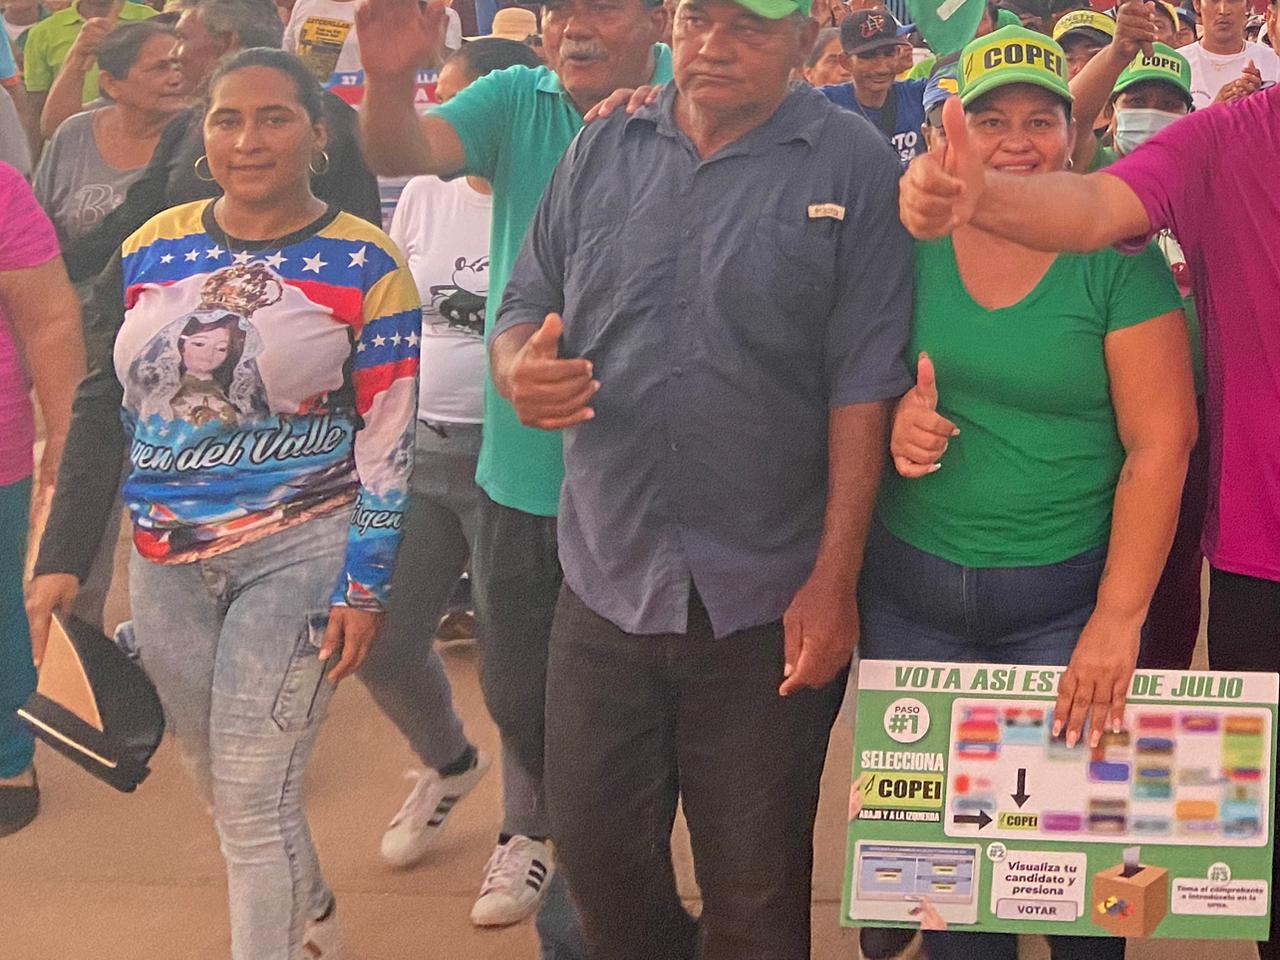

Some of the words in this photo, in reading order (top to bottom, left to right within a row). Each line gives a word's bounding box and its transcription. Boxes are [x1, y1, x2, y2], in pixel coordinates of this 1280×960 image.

[984, 43, 1063, 78] COPEI
[1141, 56, 1181, 74] COPEI
[176, 431, 245, 472] del
[250, 417, 347, 464] Valle
[895, 666, 961, 689] VOTA
[970, 666, 1017, 691] ASÍ
[1131, 674, 1165, 697] DE
[1171, 675, 1243, 699] JULIO
[895, 706, 920, 714] PASO
[889, 714, 919, 734] #1
[861, 750, 944, 772] SELECCIONA
[878, 778, 942, 800] COPEI
[1006, 815, 1038, 827] COPEI
[1008, 861, 1061, 872] Visualiza
[1064, 864, 1077, 873] tu
[1005, 873, 1065, 884] candidato
[1068, 877, 1077, 887] y
[1012, 885, 1064, 896] presiona
[1017, 905, 1057, 915] VOTAR
